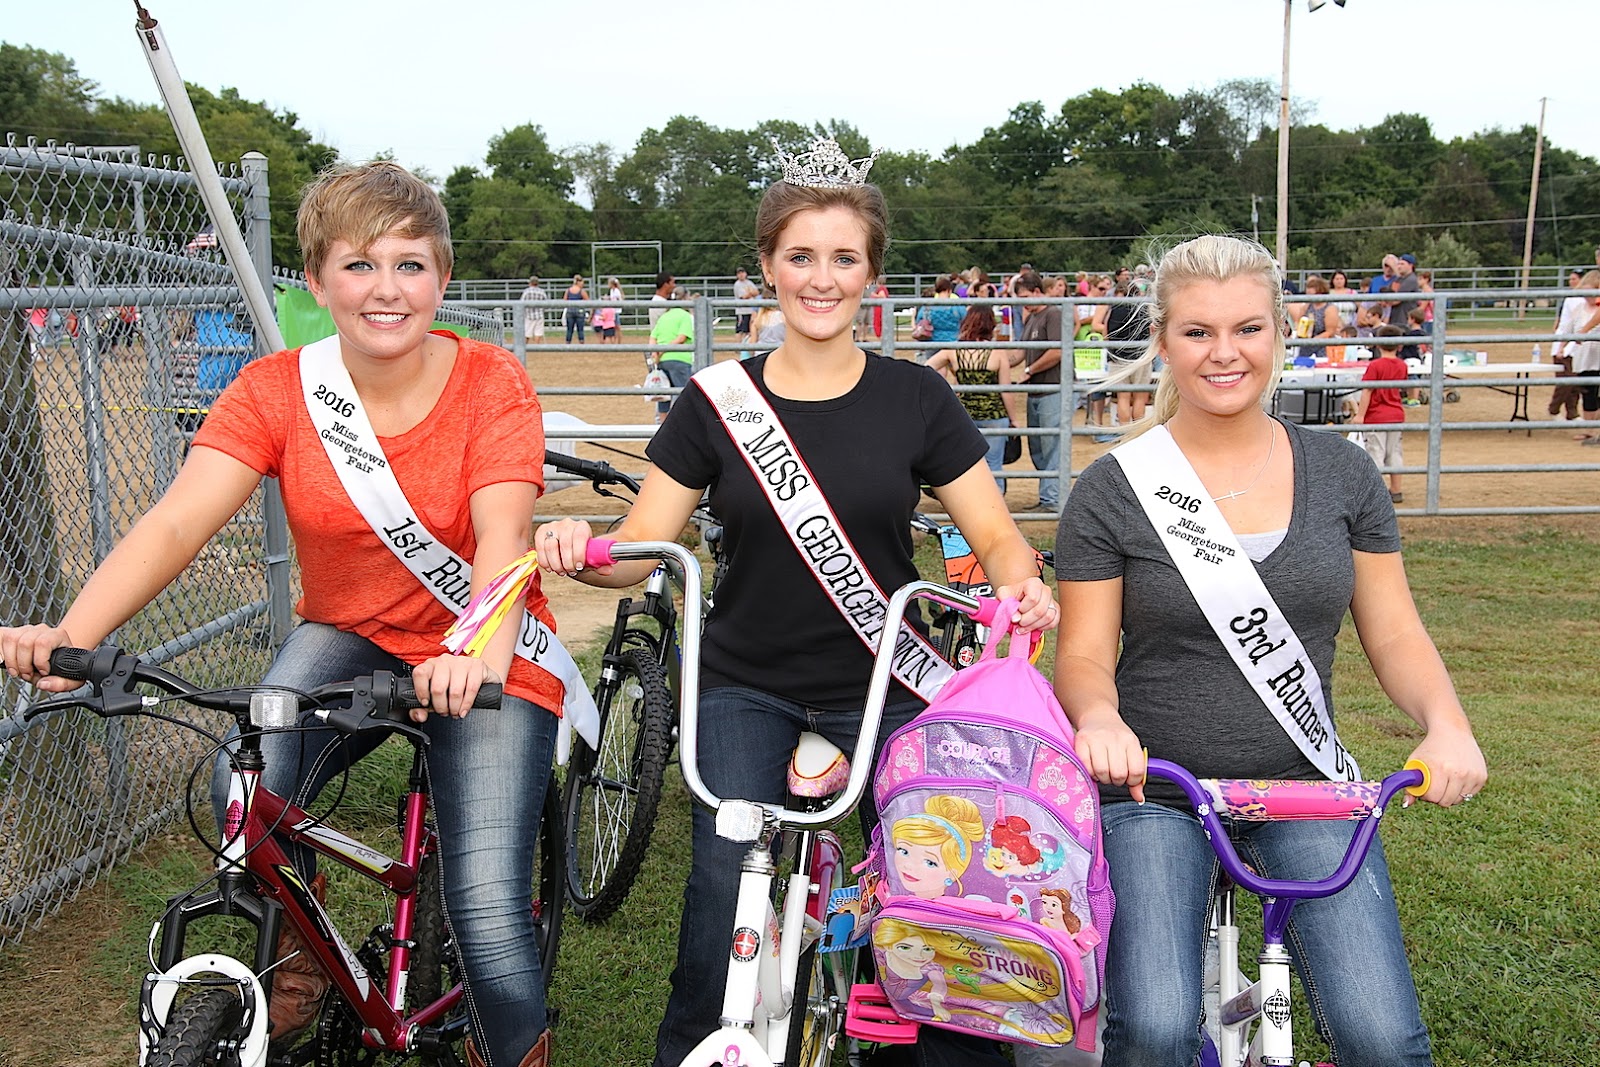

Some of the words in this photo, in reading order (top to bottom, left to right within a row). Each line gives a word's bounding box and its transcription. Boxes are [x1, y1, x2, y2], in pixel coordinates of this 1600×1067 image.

[313, 384, 355, 417] 2016
[331, 421, 359, 442] Miss
[726, 410, 764, 424] 2016
[321, 429, 386, 468] Georgetown
[742, 425, 810, 501] MISS
[345, 455, 374, 475] Fair
[1154, 485, 1202, 514] 2016
[383, 518, 433, 559] 1st
[1166, 525, 1236, 557] Georgetown
[1177, 517, 1206, 535] Miss
[1193, 548, 1223, 566] Fair
[1230, 607, 1287, 666] 3rd
[1266, 659, 1329, 753] Runner
[969, 951, 1053, 986] STRONG
